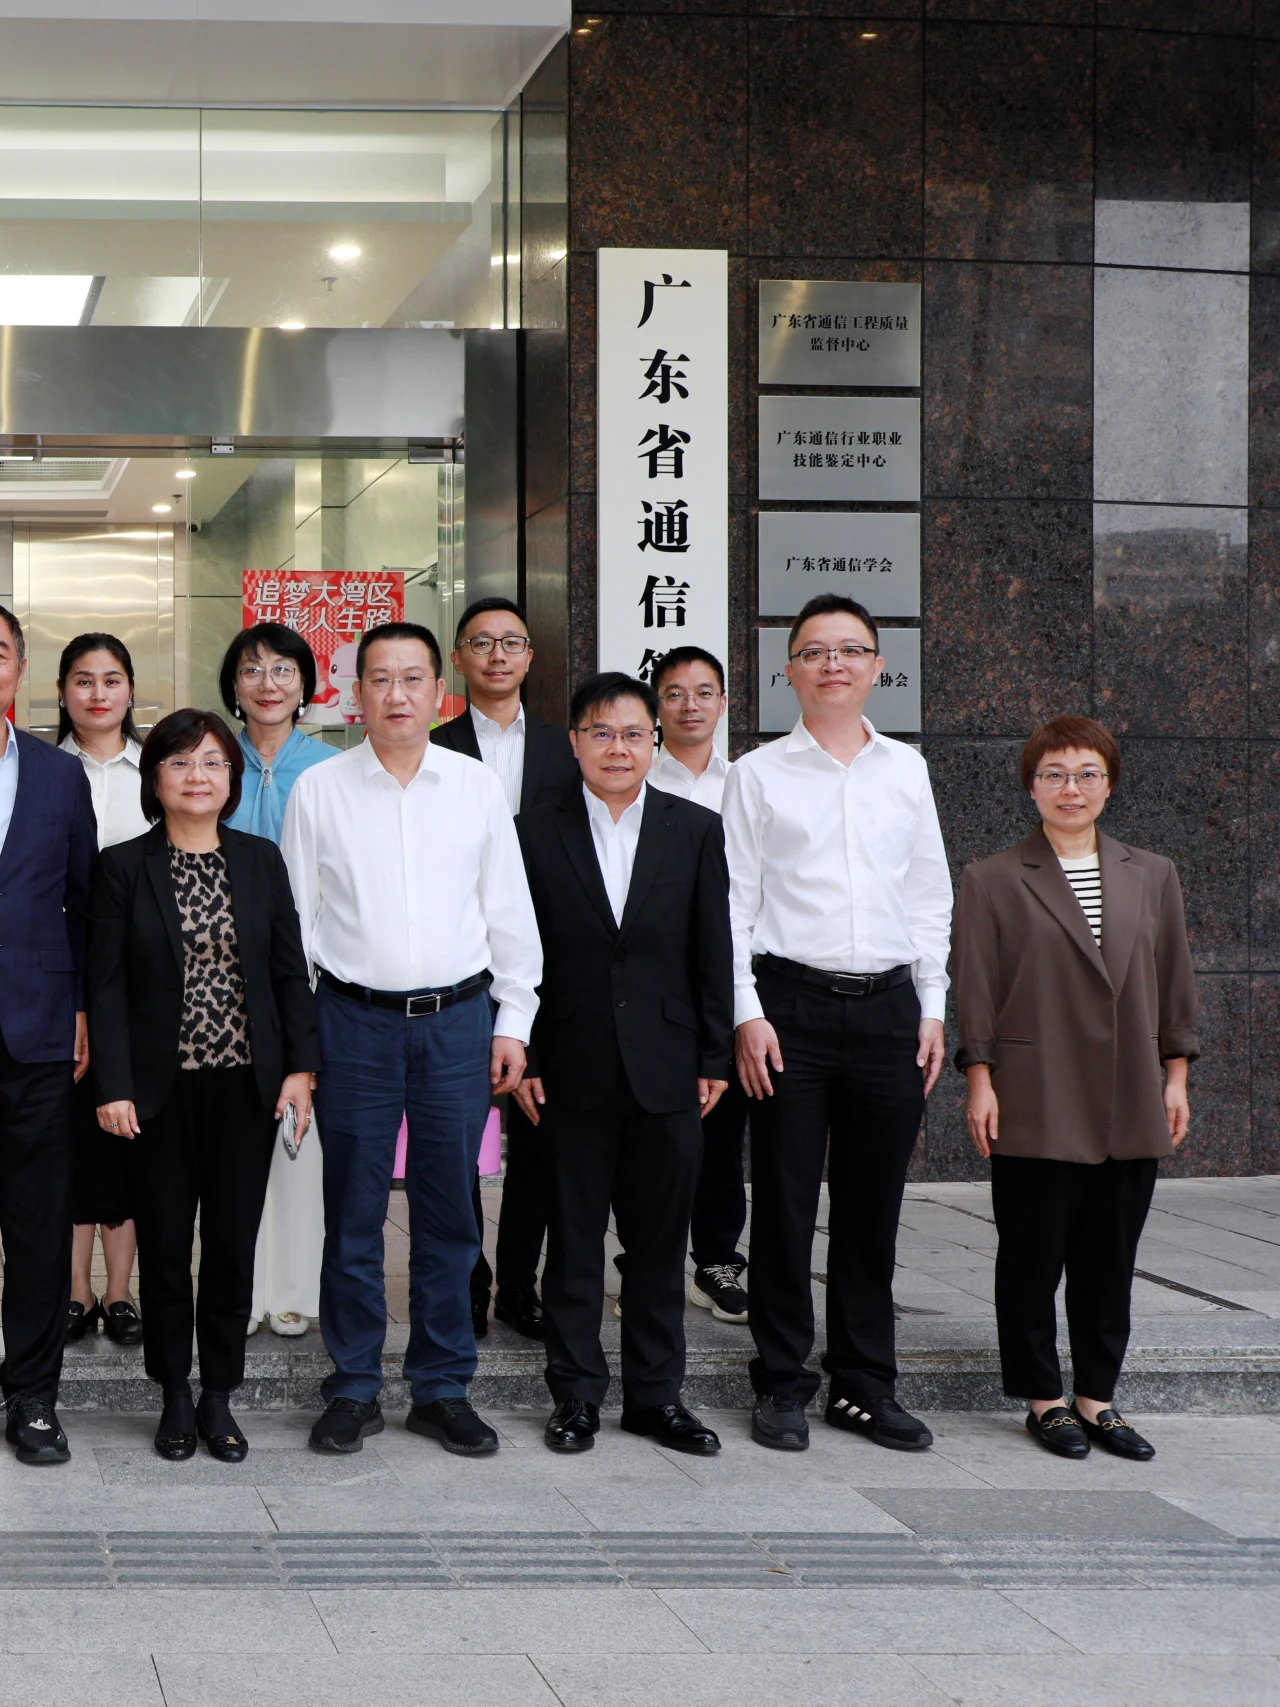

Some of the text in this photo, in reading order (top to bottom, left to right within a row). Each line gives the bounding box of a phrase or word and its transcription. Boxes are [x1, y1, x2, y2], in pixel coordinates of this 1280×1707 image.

[772, 313, 909, 331] 广东省通信工程质量
[810, 337, 870, 352] 监督中心
[776, 430, 902, 446] 广东通信行业职业
[793, 453, 886, 468] 技能鉴定中心
[637, 273, 692, 753] 广东省通信
[785, 556, 893, 572] 广东省通信学会
[253, 580, 394, 607] 追梦大湾区
